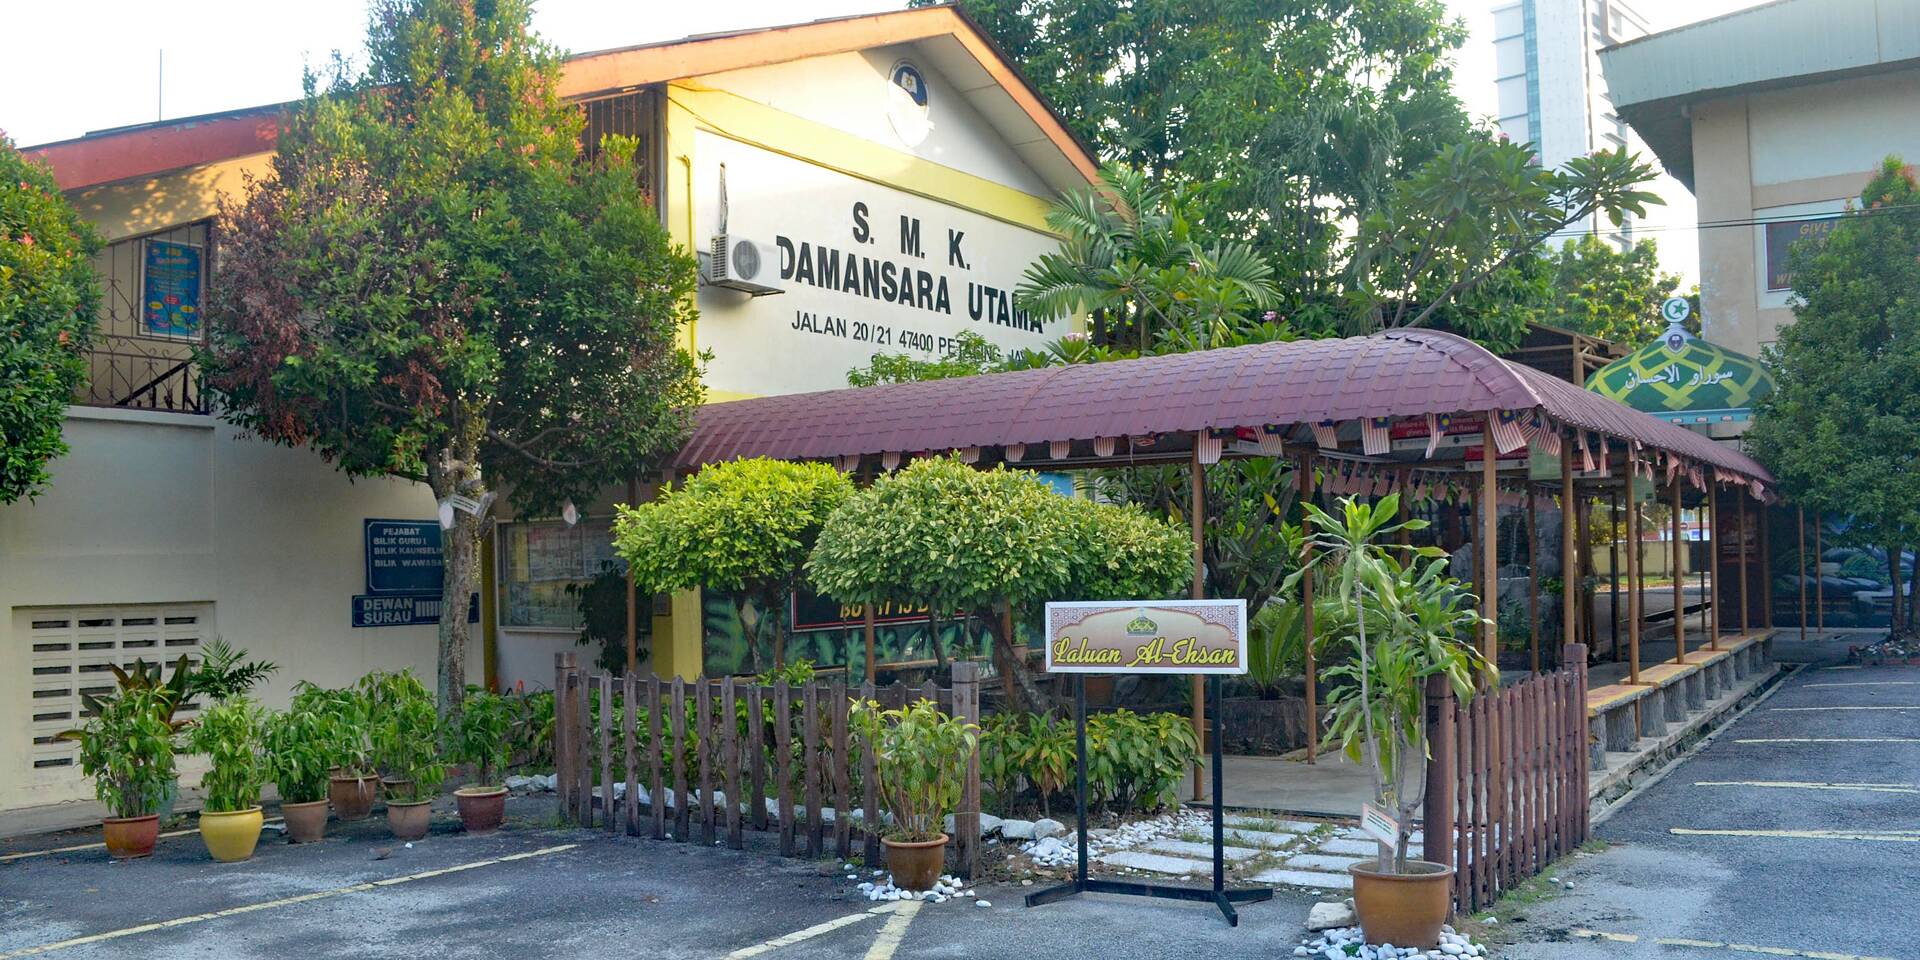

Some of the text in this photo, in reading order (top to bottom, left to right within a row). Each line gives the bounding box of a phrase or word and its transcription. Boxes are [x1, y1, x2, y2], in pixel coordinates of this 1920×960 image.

[1800, 222, 1829, 235] GIVE
[853, 201, 971, 270] S. M. K.
[776, 235, 951, 315] DAMANSARA
[791, 310, 847, 338] JALAN
[852, 321, 891, 345] 20/21
[899, 330, 934, 352] 47400
[939, 337, 1001, 362] PETING
[383, 528, 421, 536] PEJABAT
[373, 537, 396, 545] BILIK
[399, 537, 421, 545] GURU
[374, 546, 443, 555] BILIK KAUNSELI
[402, 559, 442, 567] WAWASA
[363, 597, 413, 610] DEWAN
[363, 611, 412, 624] SURAU
[1053, 636, 1236, 667] Laluan Al-Ehsan
